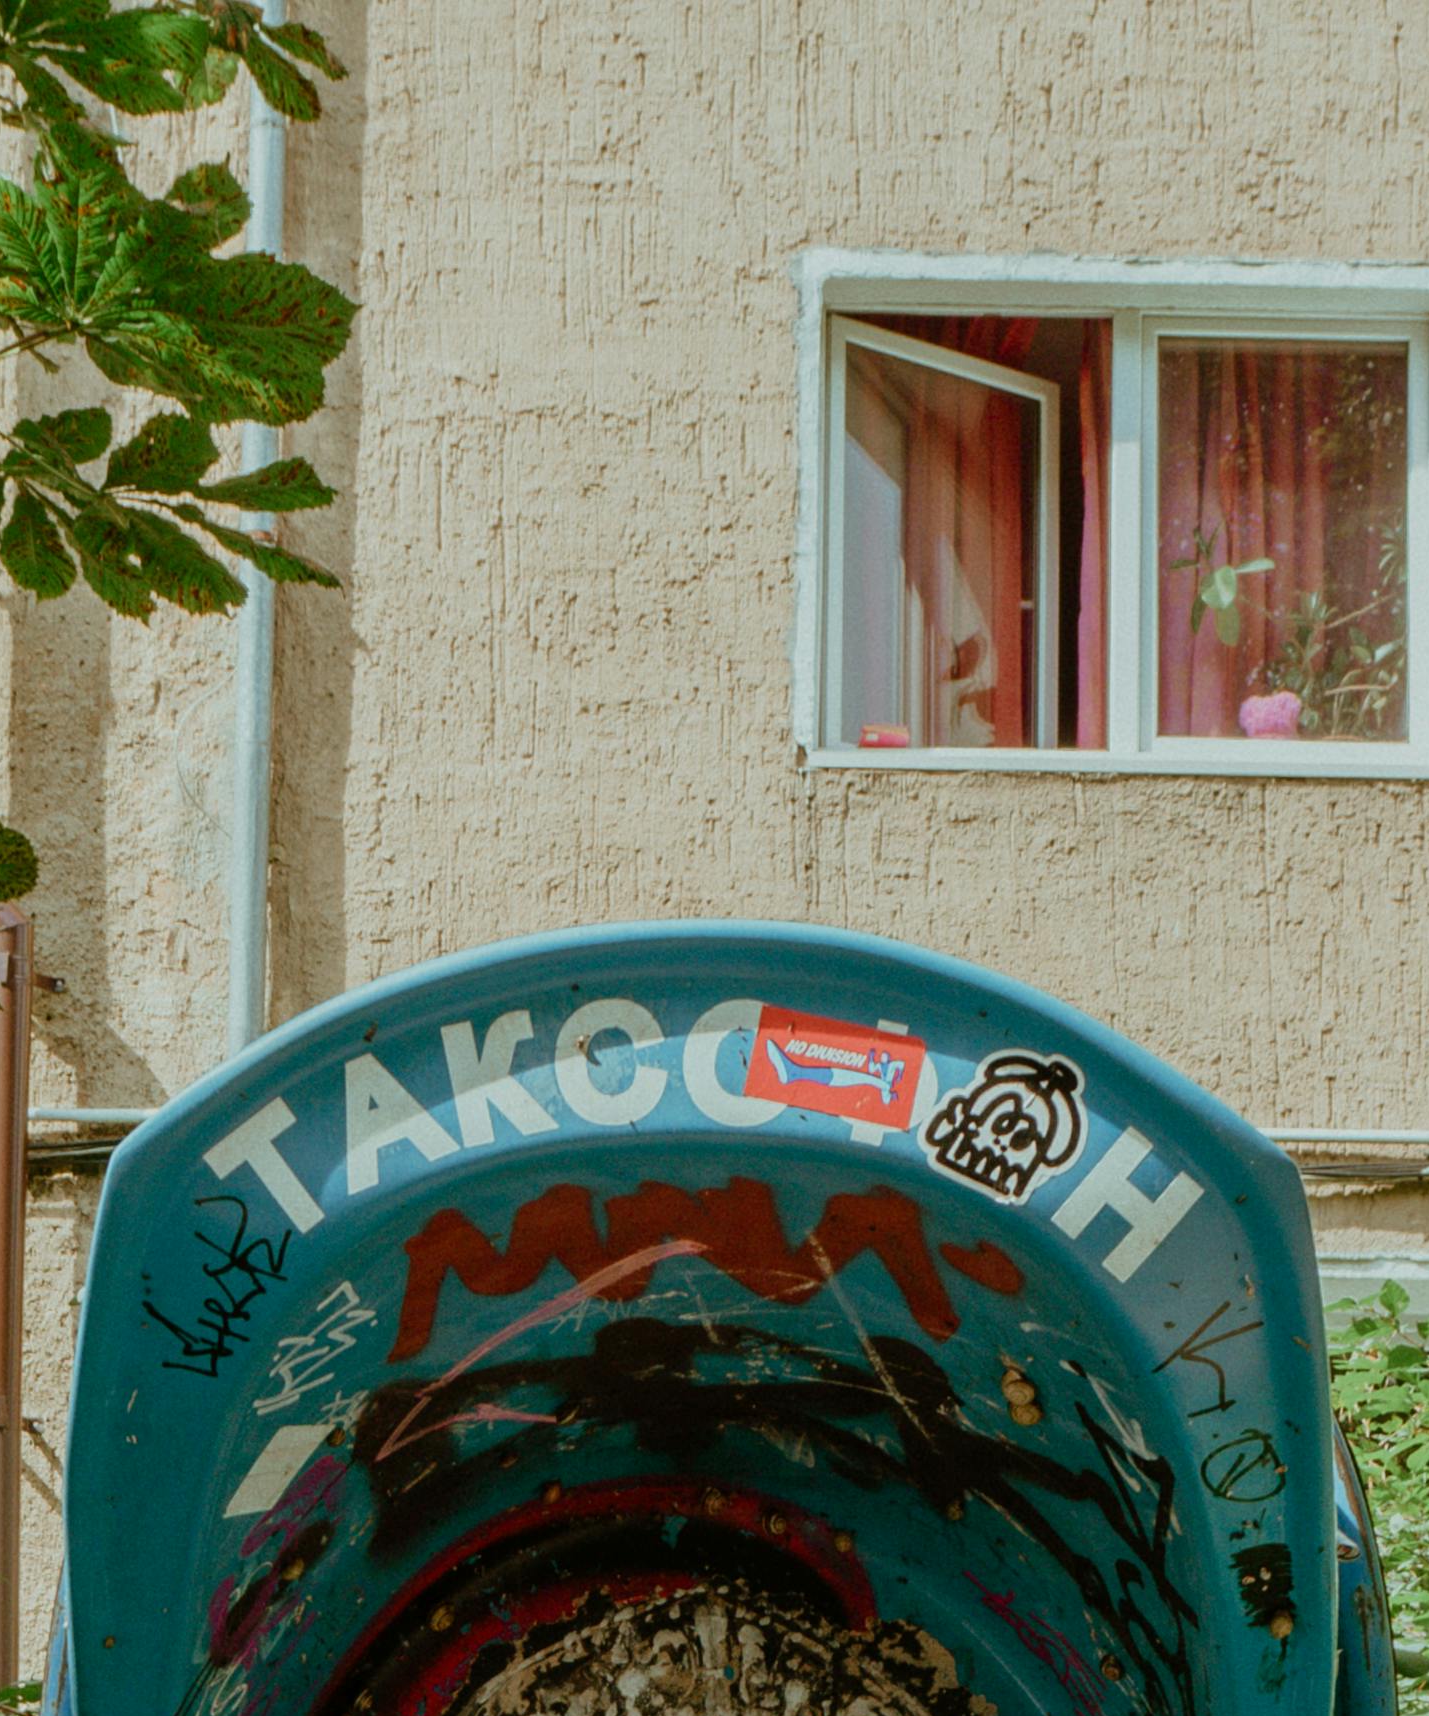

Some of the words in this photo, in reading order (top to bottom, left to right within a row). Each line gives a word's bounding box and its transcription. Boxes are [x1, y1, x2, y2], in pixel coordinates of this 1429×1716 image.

[784, 1039, 804, 1056] NO
[805, 1045, 868, 1069] DIVISION
[202, 997, 1205, 1284] ТАКСОН
